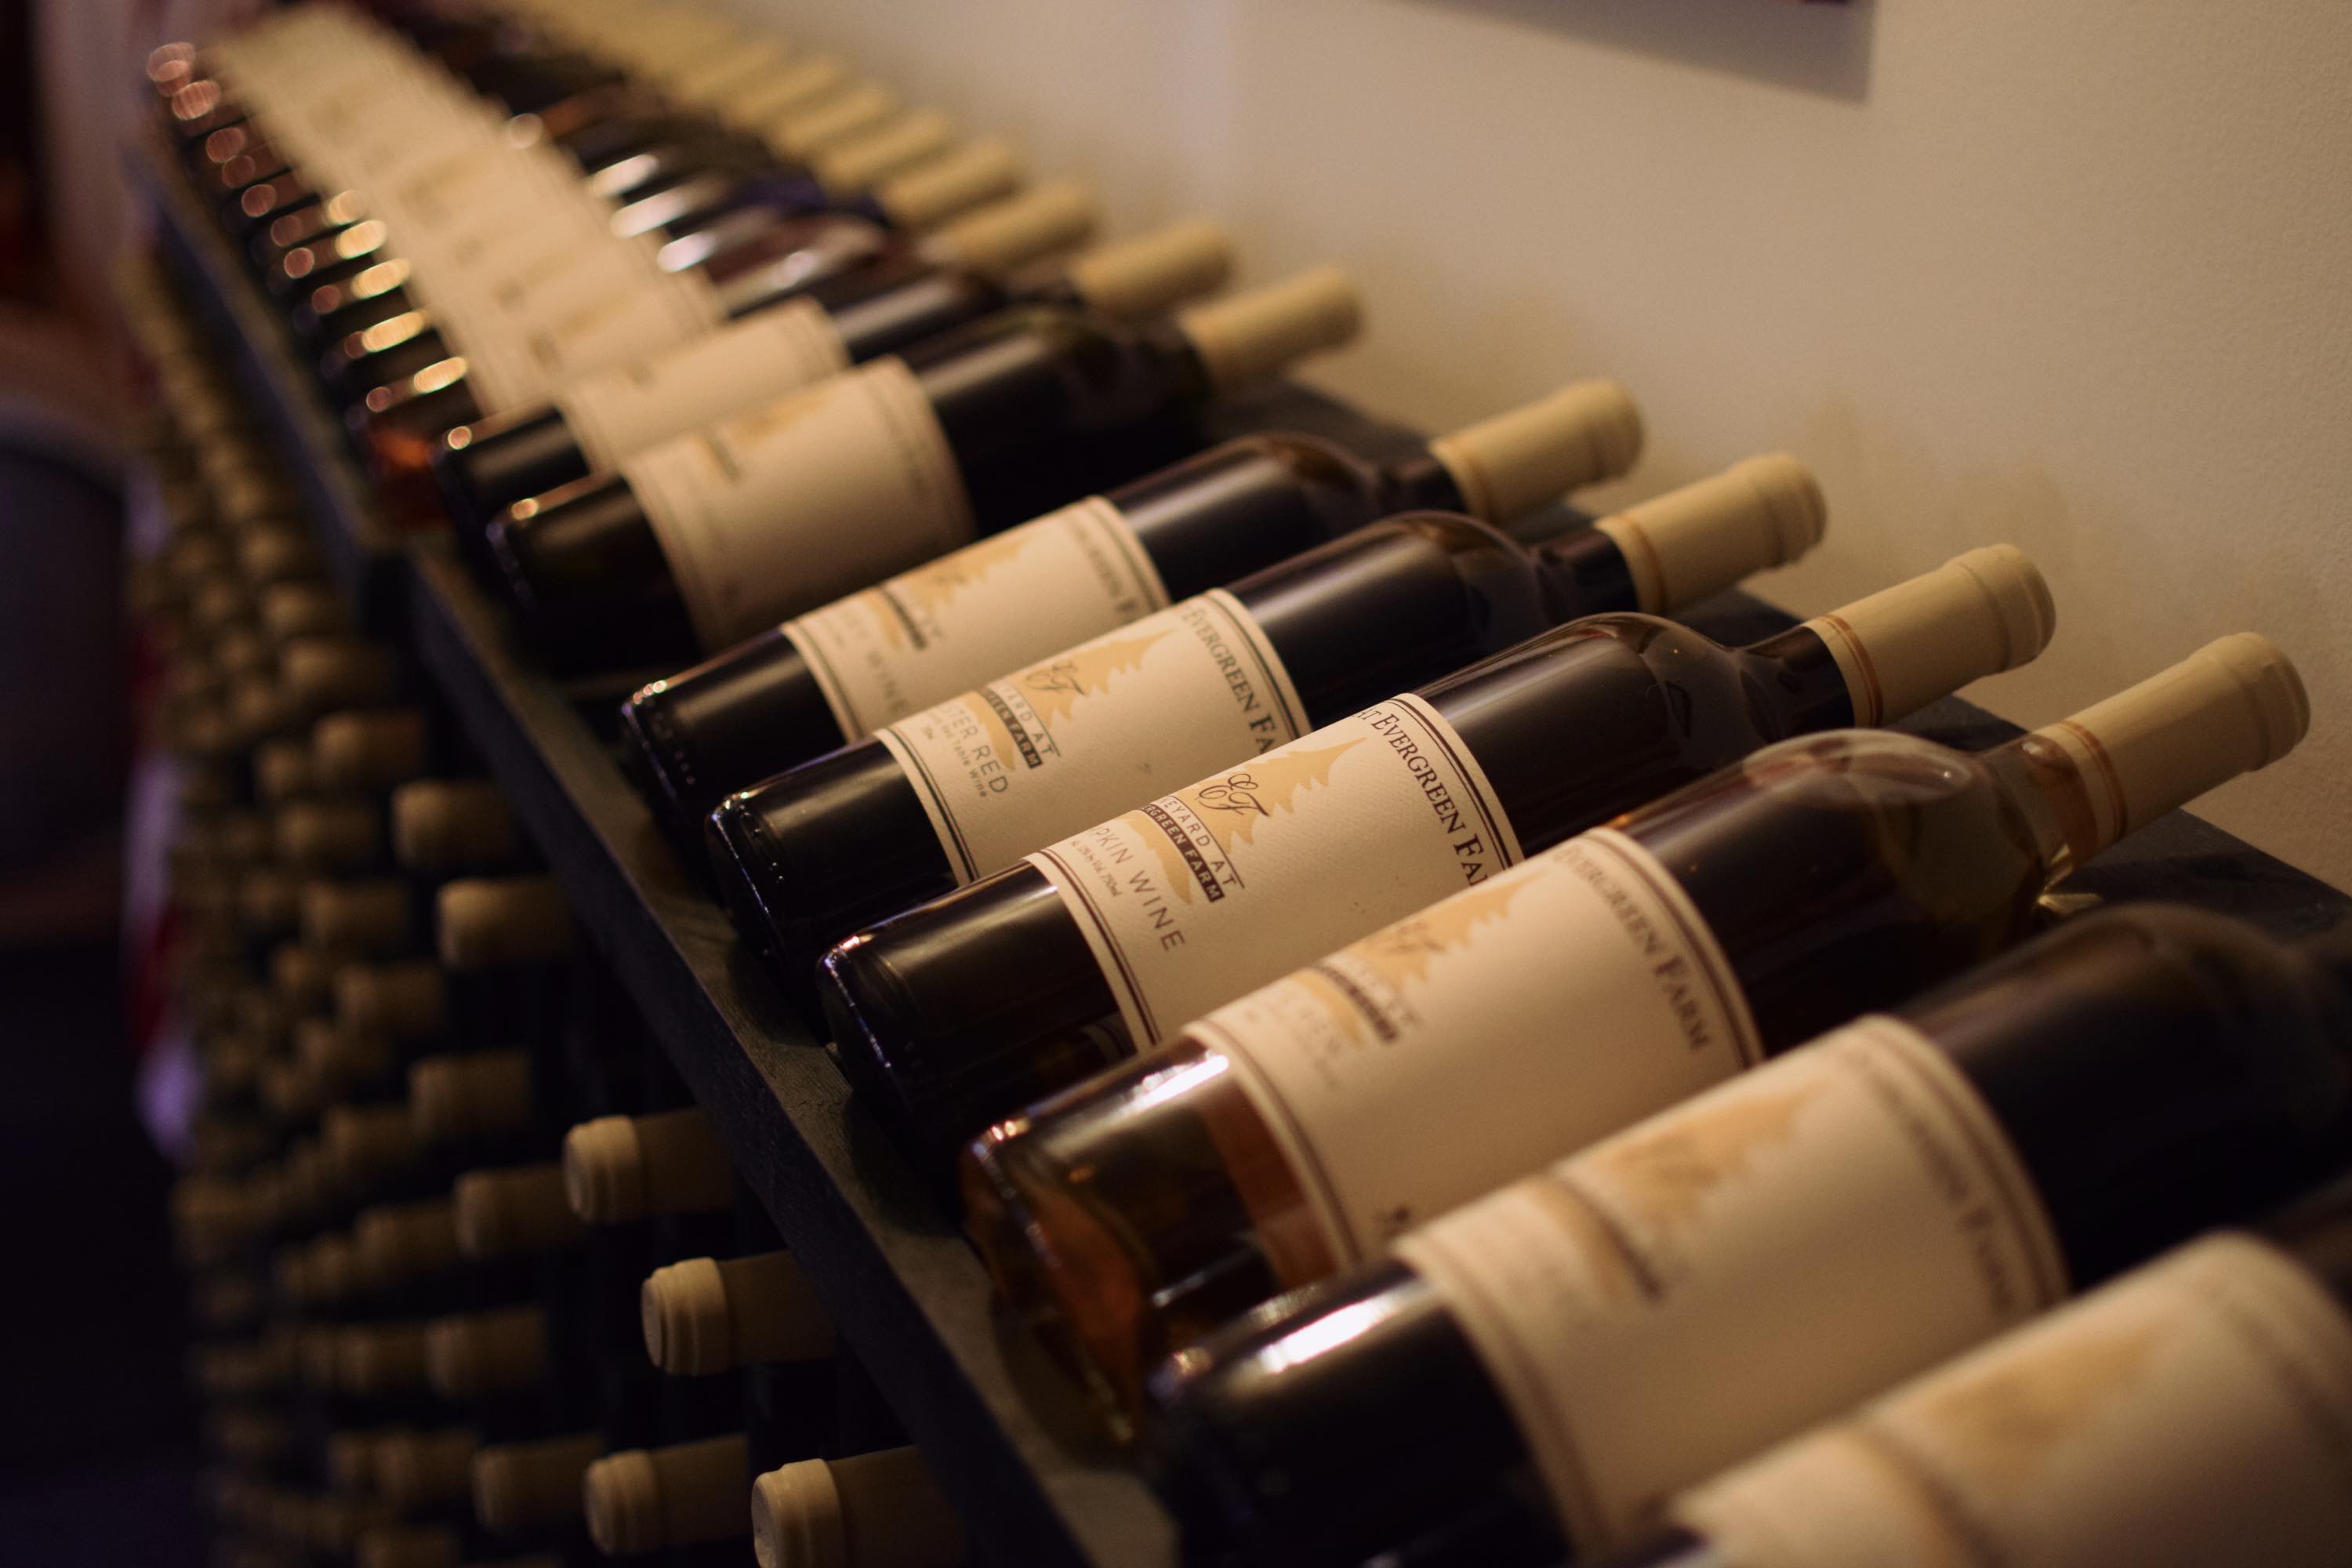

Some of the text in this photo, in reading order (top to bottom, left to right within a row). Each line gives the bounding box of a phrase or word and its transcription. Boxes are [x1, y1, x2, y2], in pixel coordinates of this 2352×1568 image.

[1181, 608, 1277, 754] EVERGREEN FA
[971, 745, 1008, 793] RED
[1031, 732, 1055, 754] AT
[1370, 713, 1467, 835] EVERGREEN
[1091, 826, 1186, 952] PKIN WINE
[1184, 848, 1221, 900] FARM
[1210, 860, 1237, 887] AT
